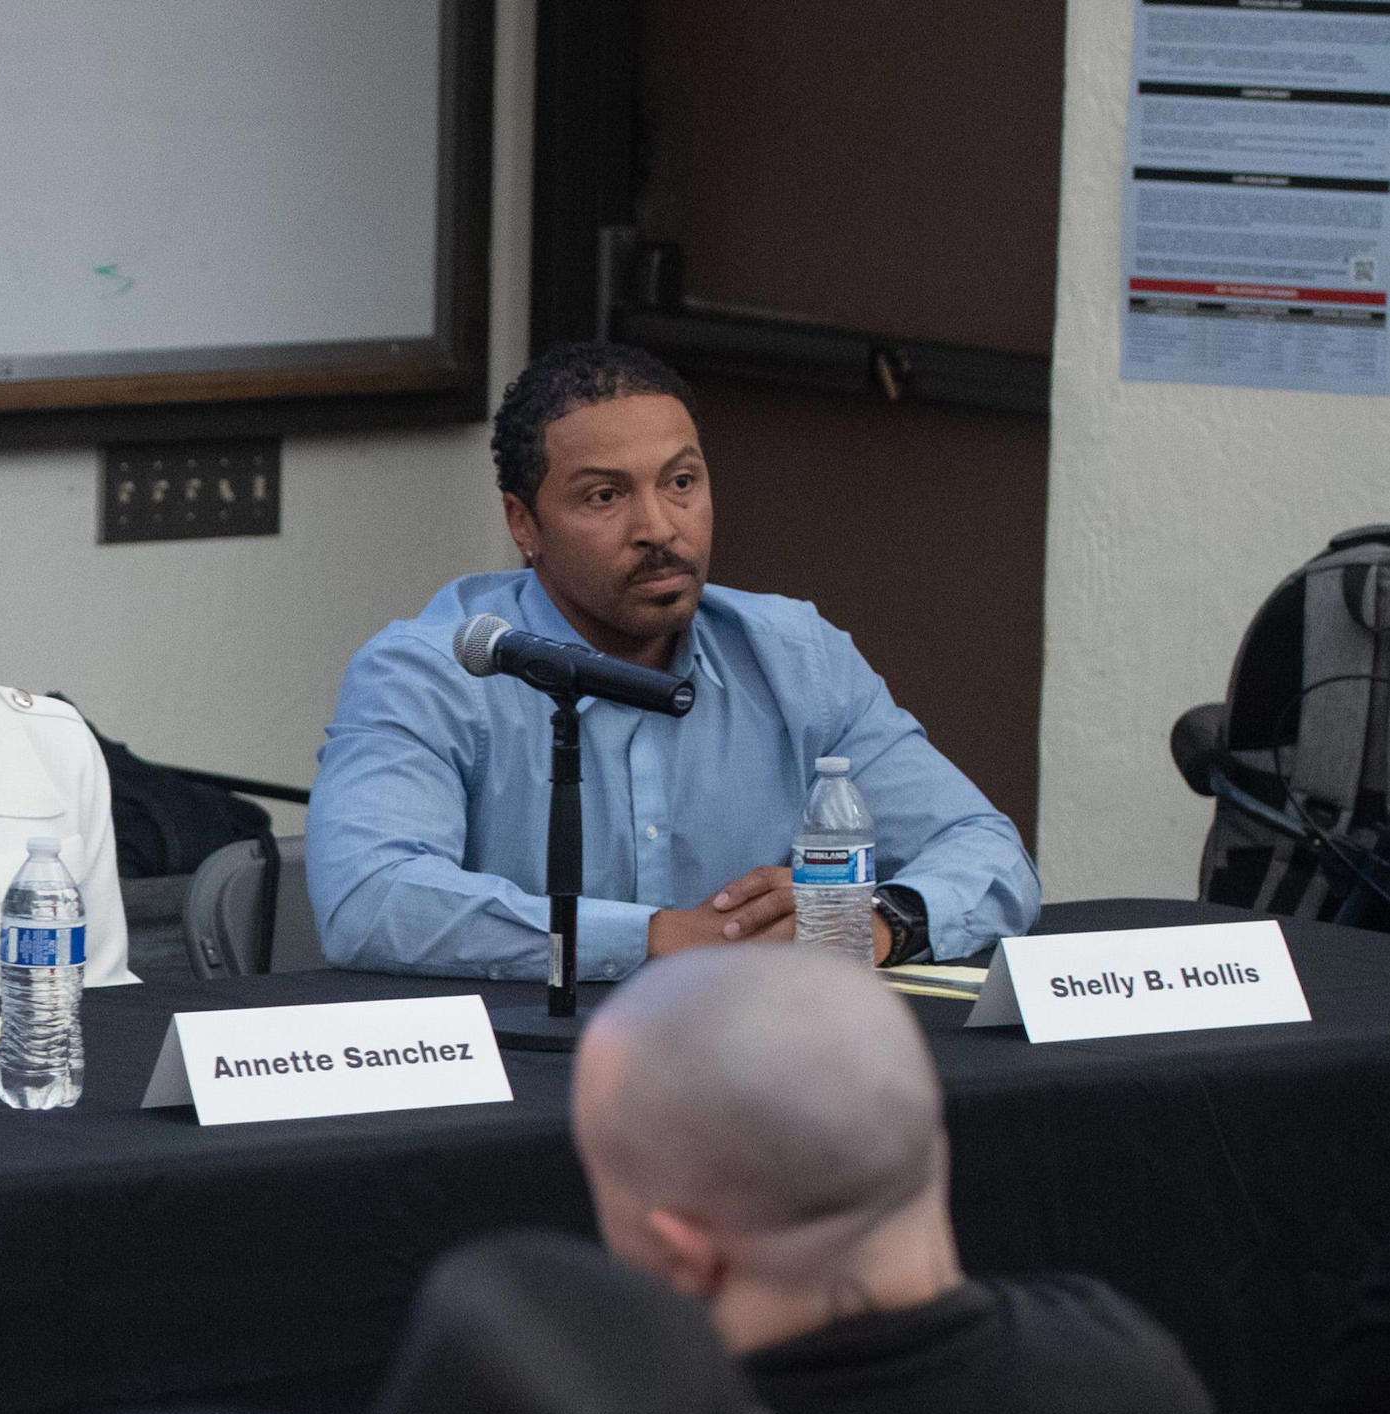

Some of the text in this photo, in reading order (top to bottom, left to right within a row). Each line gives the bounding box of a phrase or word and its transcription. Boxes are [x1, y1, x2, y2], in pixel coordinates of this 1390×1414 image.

[1050, 963, 1260, 999] Shelly B. Hollis
[214, 1040, 474, 1079] Annette Sanchez
